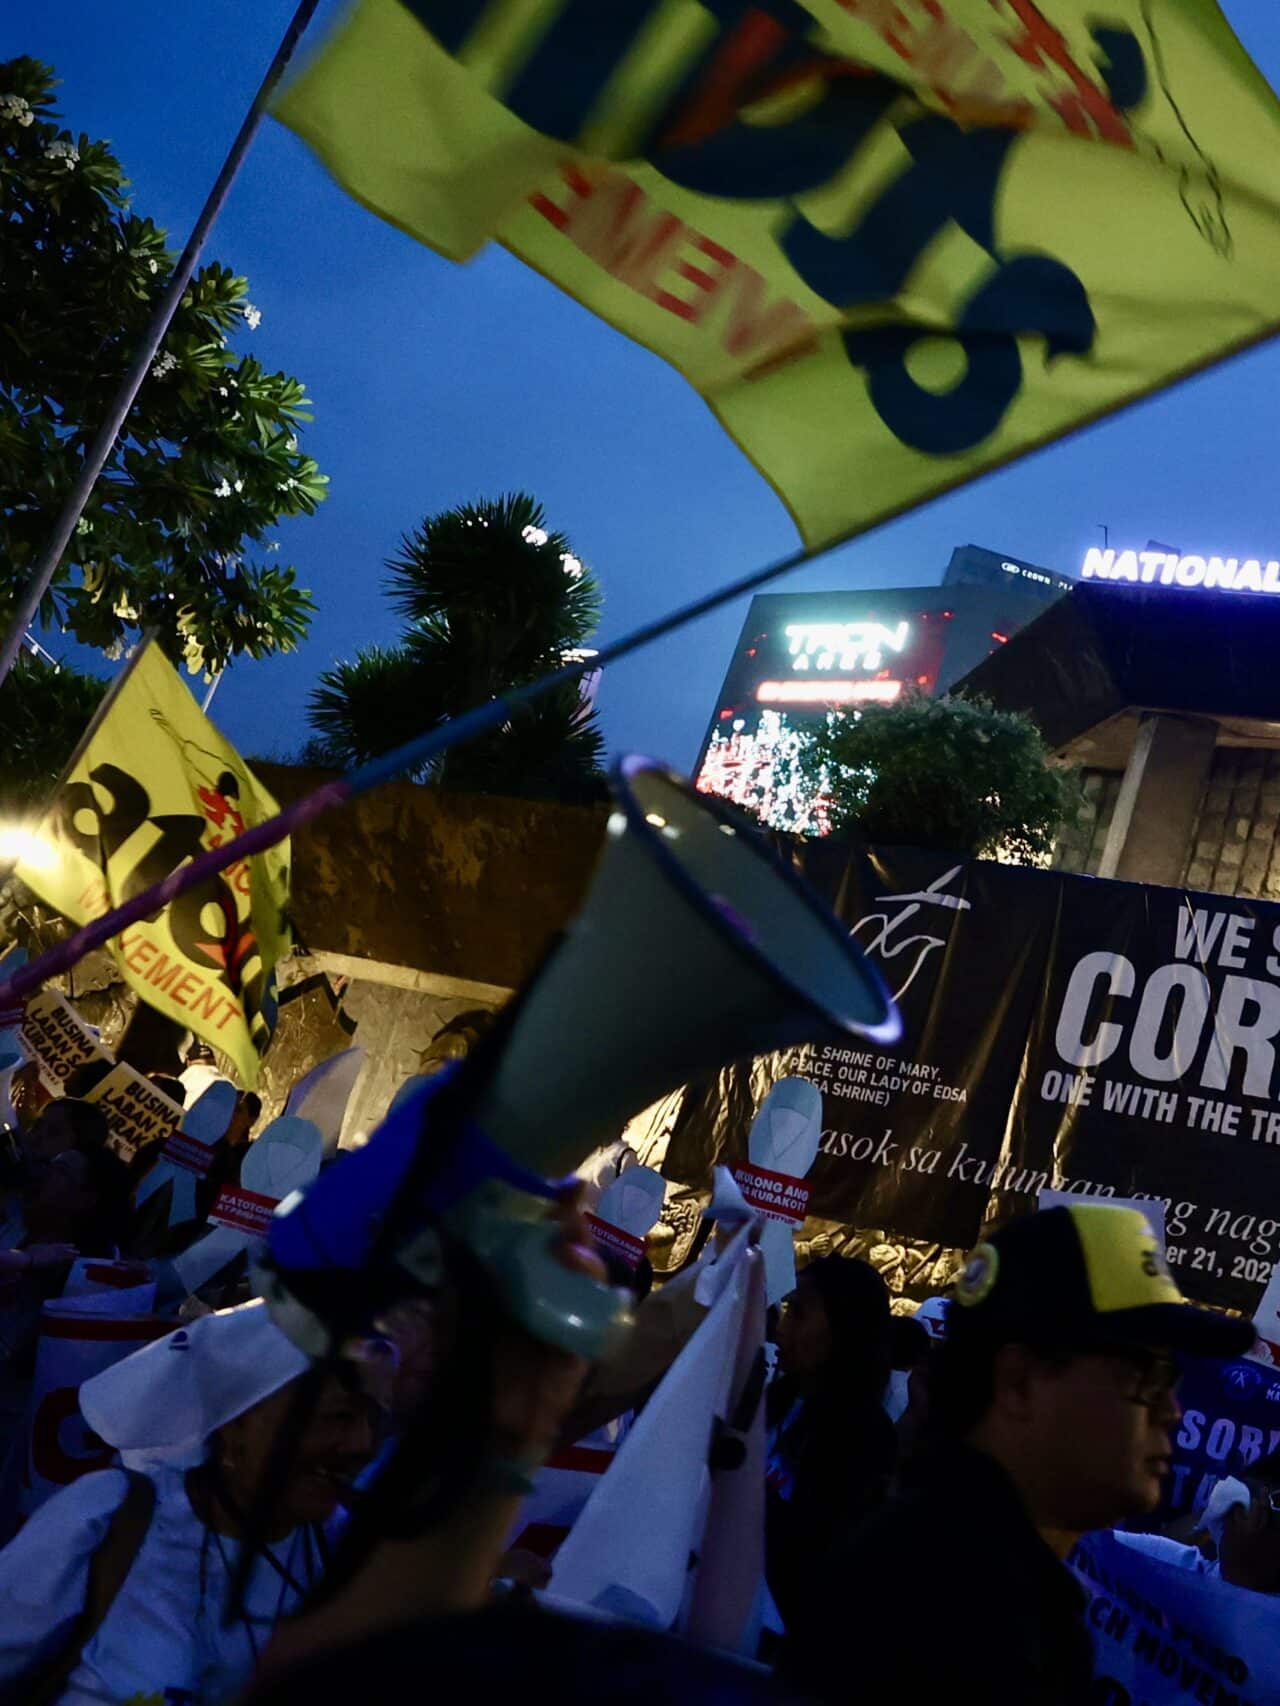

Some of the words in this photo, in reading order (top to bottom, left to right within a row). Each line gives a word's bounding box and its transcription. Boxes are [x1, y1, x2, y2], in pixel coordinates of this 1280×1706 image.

[1174, 905, 1256, 969] WE
[30, 1007, 73, 1060] LABAN
[50, 1006, 96, 1058] BUSINA
[821, 1046, 873, 1068] SHRINE
[875, 1056, 896, 1072] OF
[124, 1081, 181, 1127] BUSINA
[831, 1082, 891, 1107] SHRINE)
[838, 1066, 868, 1084] OUR
[870, 1073, 911, 1094] LADY
[912, 1081, 932, 1097] OF
[933, 1084, 968, 1104] EDSA
[1040, 1069, 1096, 1107] ONE
[1103, 1080, 1179, 1125] WITH
[1186, 1097, 1244, 1136] THE
[102, 1087, 159, 1139] LABAN
[819, 1128, 900, 1167] asok
[901, 1146, 942, 1175] sa
[1192, 1245, 1224, 1278] 21,
